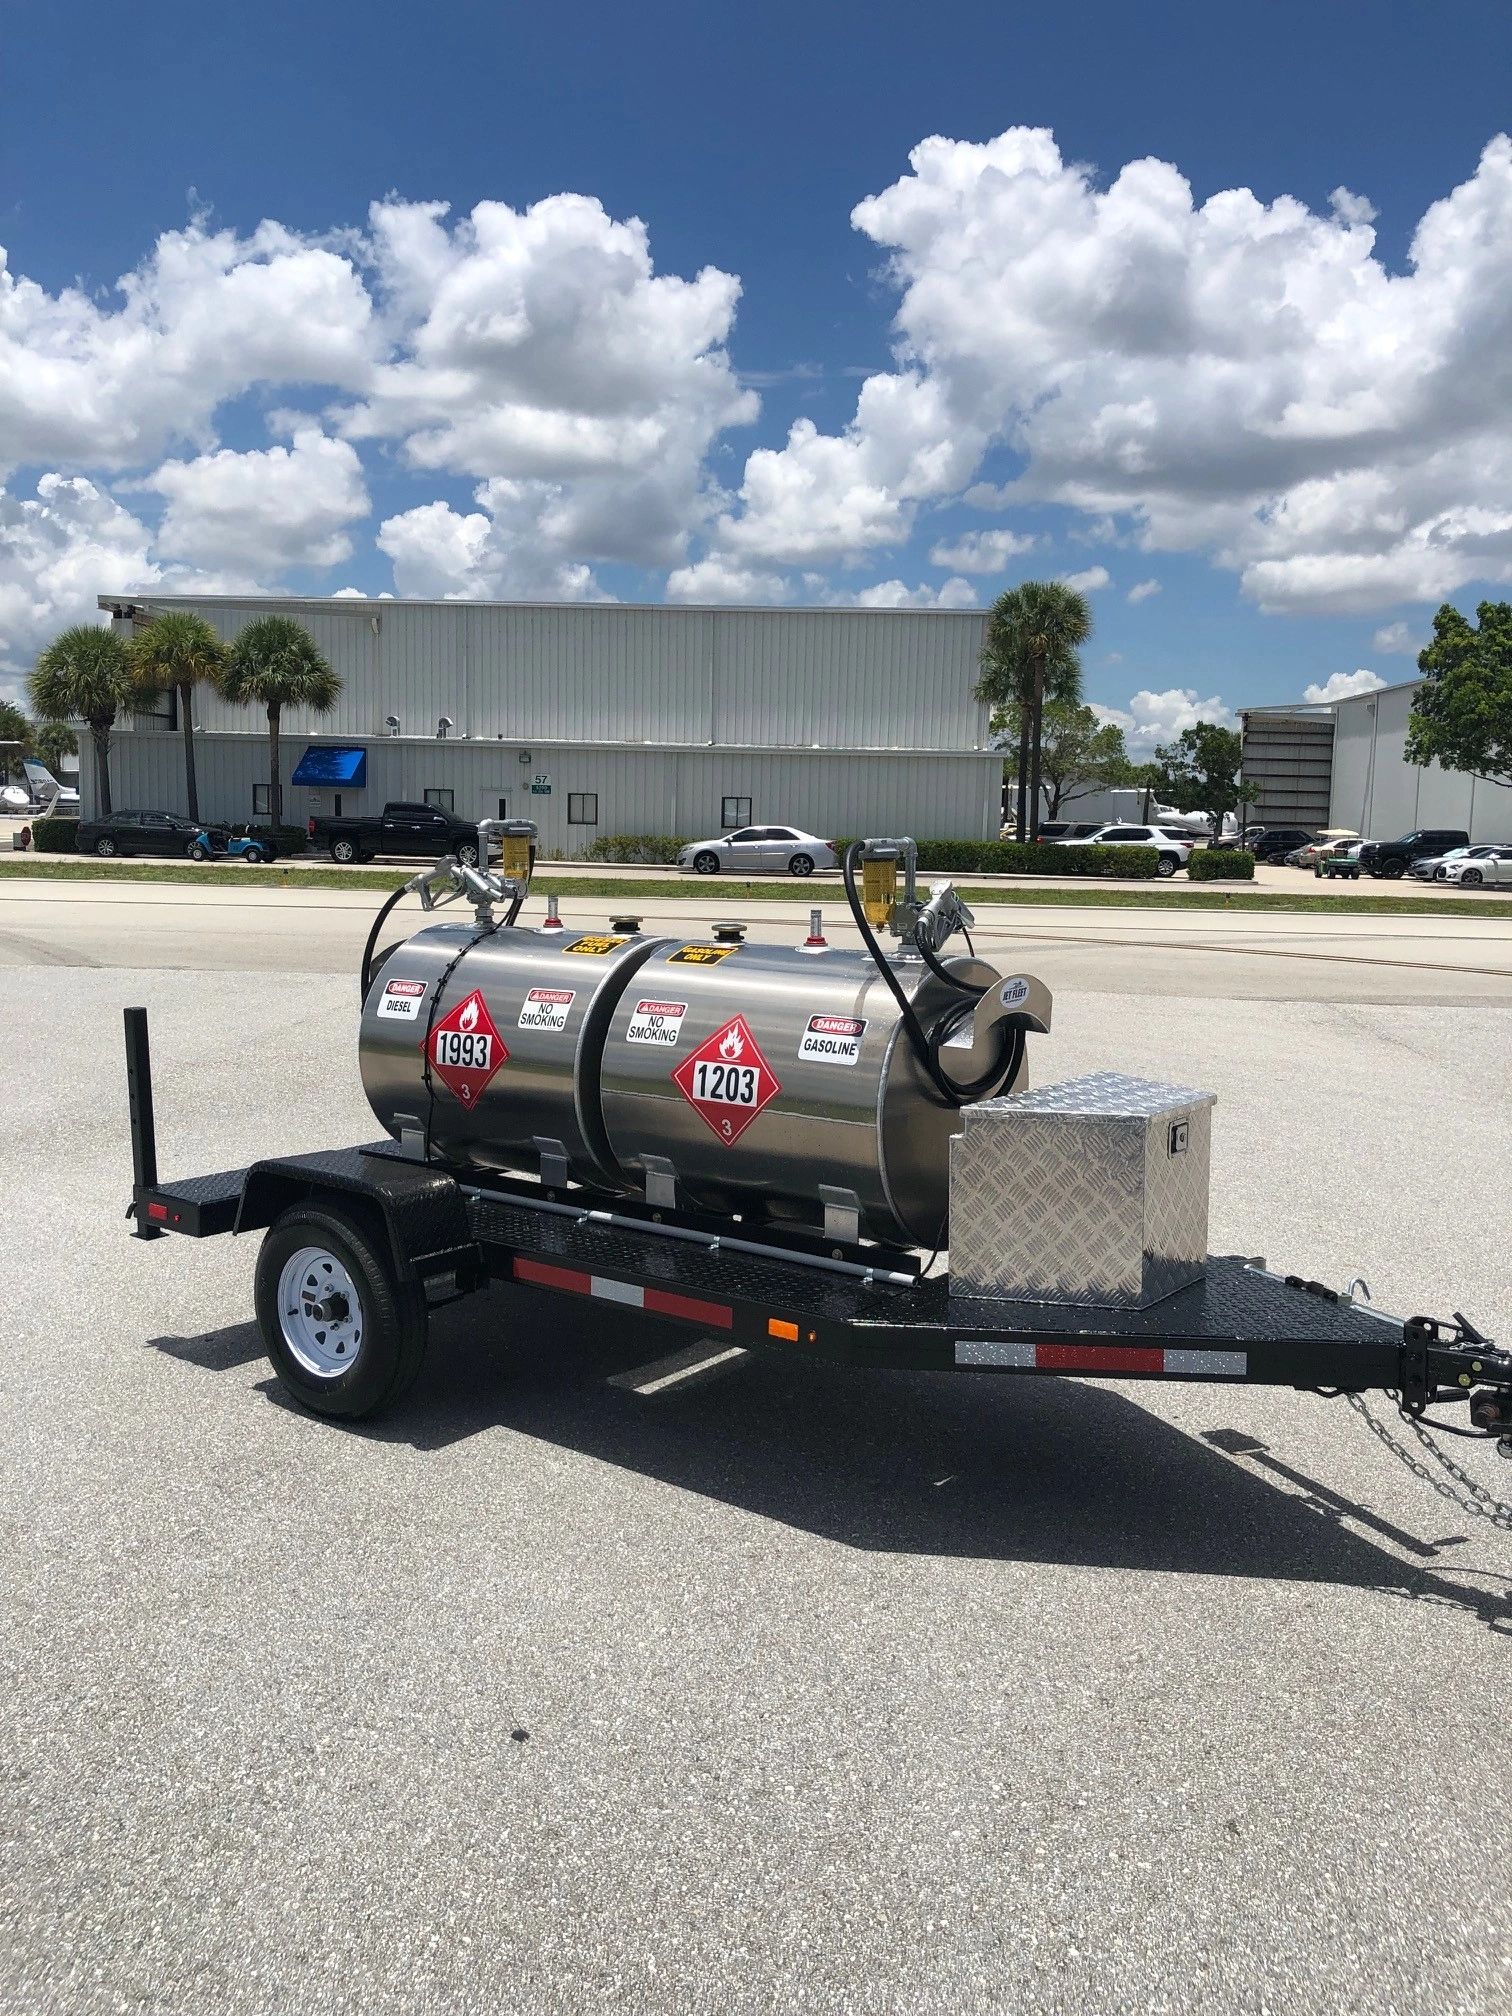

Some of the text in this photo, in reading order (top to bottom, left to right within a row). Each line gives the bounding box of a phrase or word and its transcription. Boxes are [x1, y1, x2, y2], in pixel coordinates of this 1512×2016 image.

[535, 775, 548, 784] 57
[572, 945, 607, 953] ONLY
[391, 983, 421, 994] DANGER
[1012, 987, 1027, 999] FLEET
[539, 992, 570, 1002] DANGER
[386, 1000, 411, 1012] DIESEL
[538, 1002, 553, 1014] NO
[649, 1004, 682, 1015] DANGER
[520, 1012, 565, 1027] SMOKING
[648, 1015, 664, 1027] NO
[816, 1019, 858, 1032] DANGER
[628, 1025, 677, 1041] SMOKING
[440, 1032, 488, 1068] 1993
[804, 1038, 858, 1056] GASOLINE
[698, 1064, 755, 1104] 1203
[461, 1083, 471, 1099] 3
[721, 1118, 732, 1136] 3
